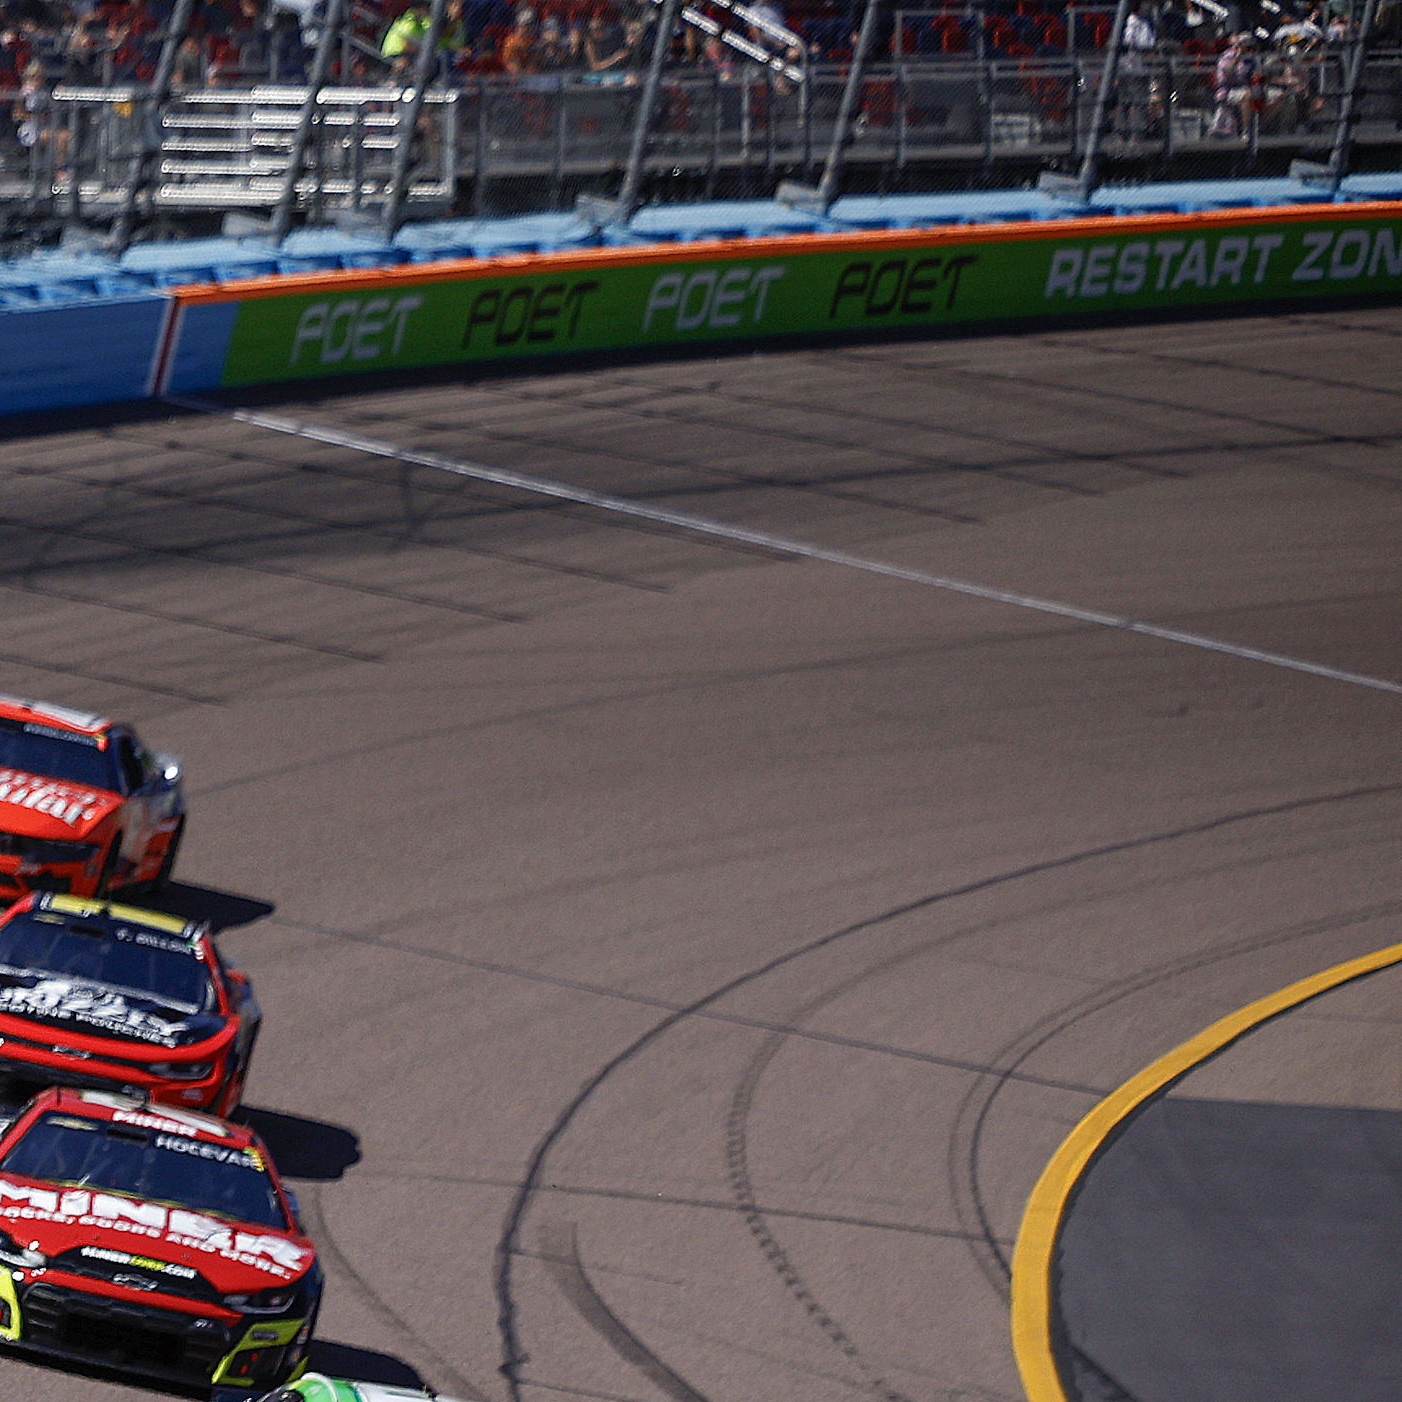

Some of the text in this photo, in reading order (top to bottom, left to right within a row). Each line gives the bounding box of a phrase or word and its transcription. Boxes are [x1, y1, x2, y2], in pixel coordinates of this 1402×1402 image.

[829, 254, 978, 319] POET
[1044, 227, 1402, 299] RESTART ZON
[290, 293, 427, 366] POET
[461, 280, 601, 350] POET
[641, 265, 786, 333] POET
